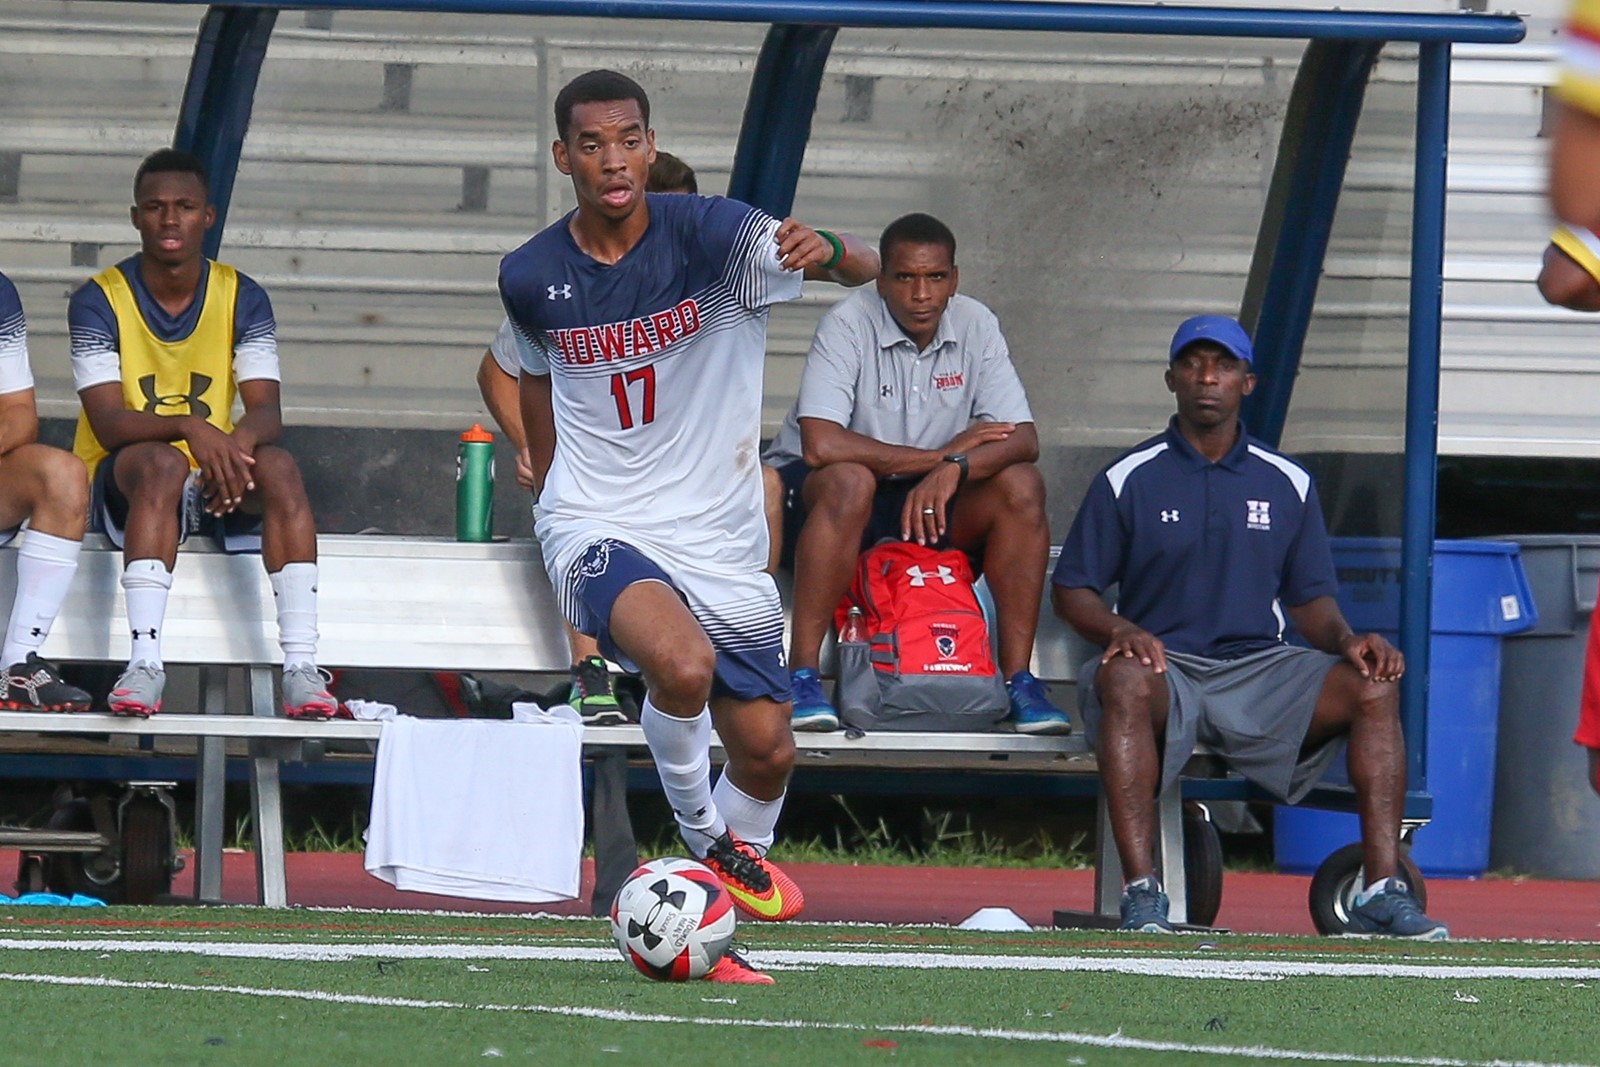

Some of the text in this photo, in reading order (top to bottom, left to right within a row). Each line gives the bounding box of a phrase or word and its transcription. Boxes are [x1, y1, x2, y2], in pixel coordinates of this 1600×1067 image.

[547, 299, 700, 365] HOWARD
[611, 364, 656, 430] 17
[1246, 500, 1271, 524] H
